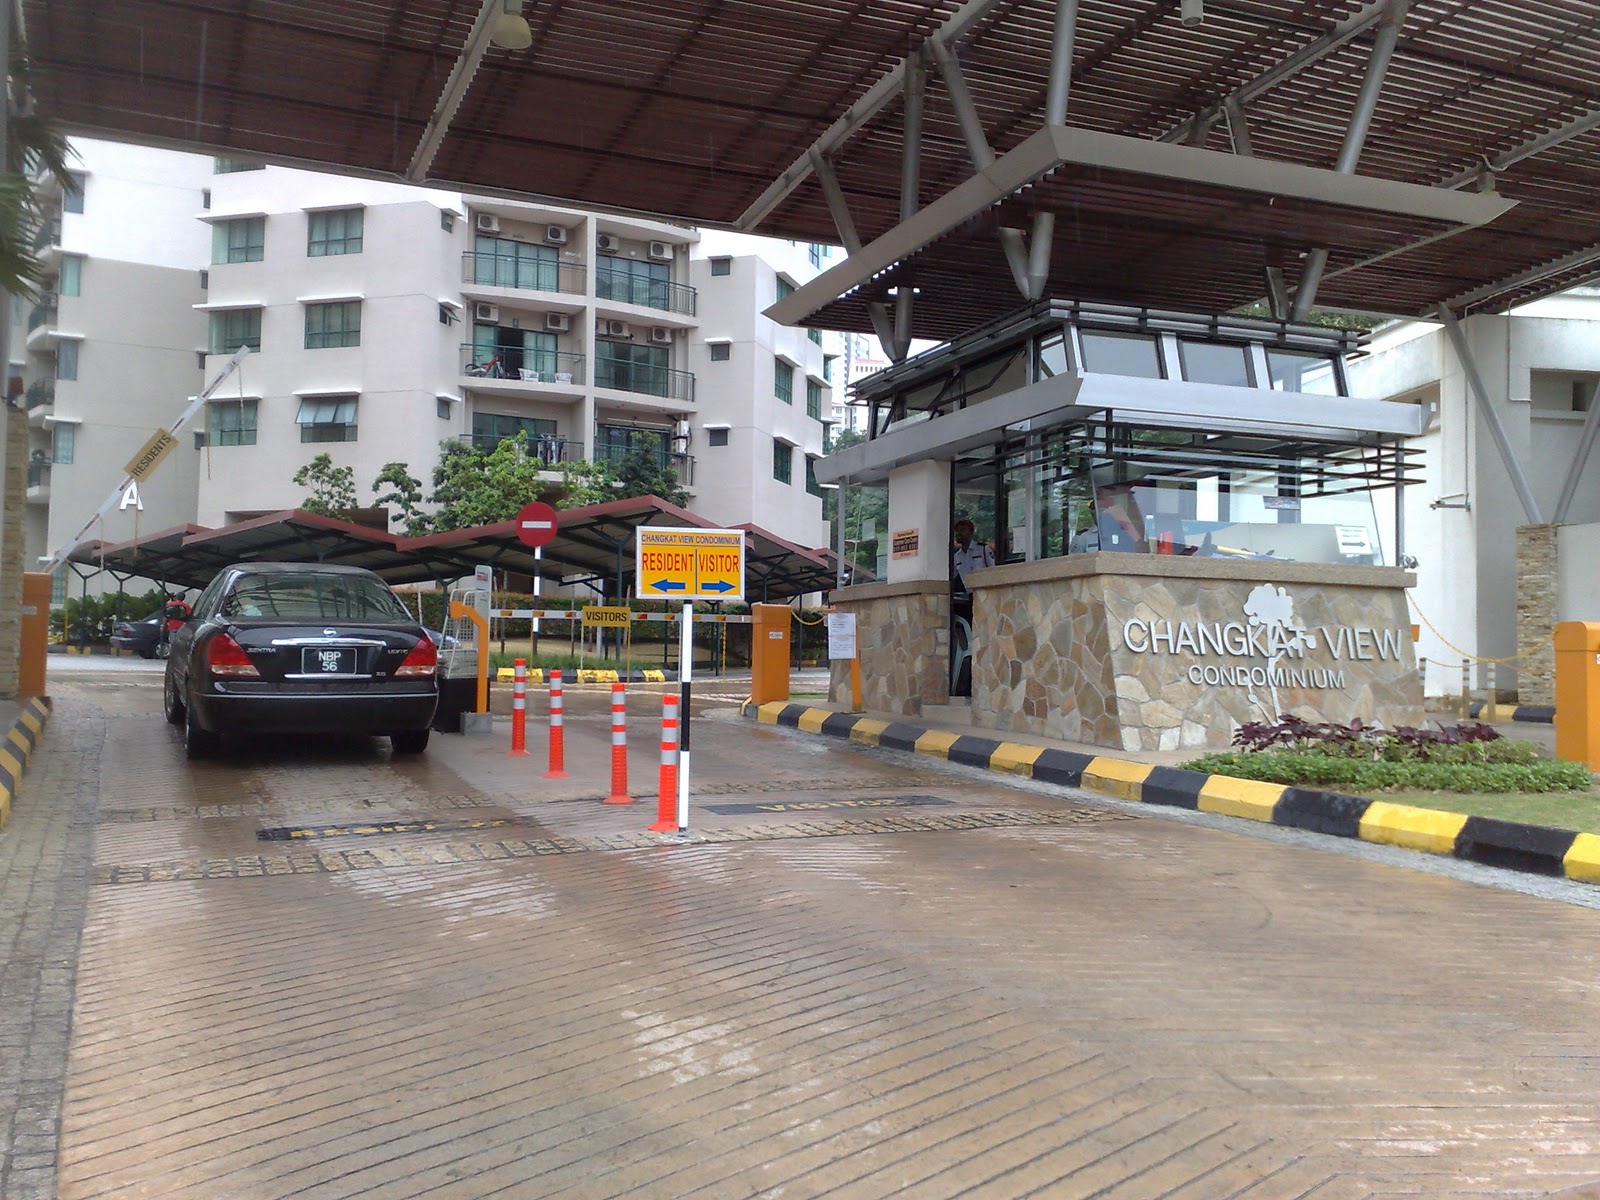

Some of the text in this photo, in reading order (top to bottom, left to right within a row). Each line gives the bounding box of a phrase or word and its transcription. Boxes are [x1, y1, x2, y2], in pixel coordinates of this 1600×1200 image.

[131, 434, 171, 477] RESIDENTS
[119, 479, 144, 511] A
[641, 533, 740, 545] CHANGKAT VIEW CONDOMINIUM
[642, 552, 694, 571] RESIDENT
[698, 554, 739, 572] VISITOR
[586, 611, 627, 622] VISITORS
[1123, 618, 1402, 661] CHANGKAT VIEW
[318, 651, 342, 661] NBP
[321, 661, 338, 671] 56
[1187, 665, 1346, 689] CONDOMINIUM
